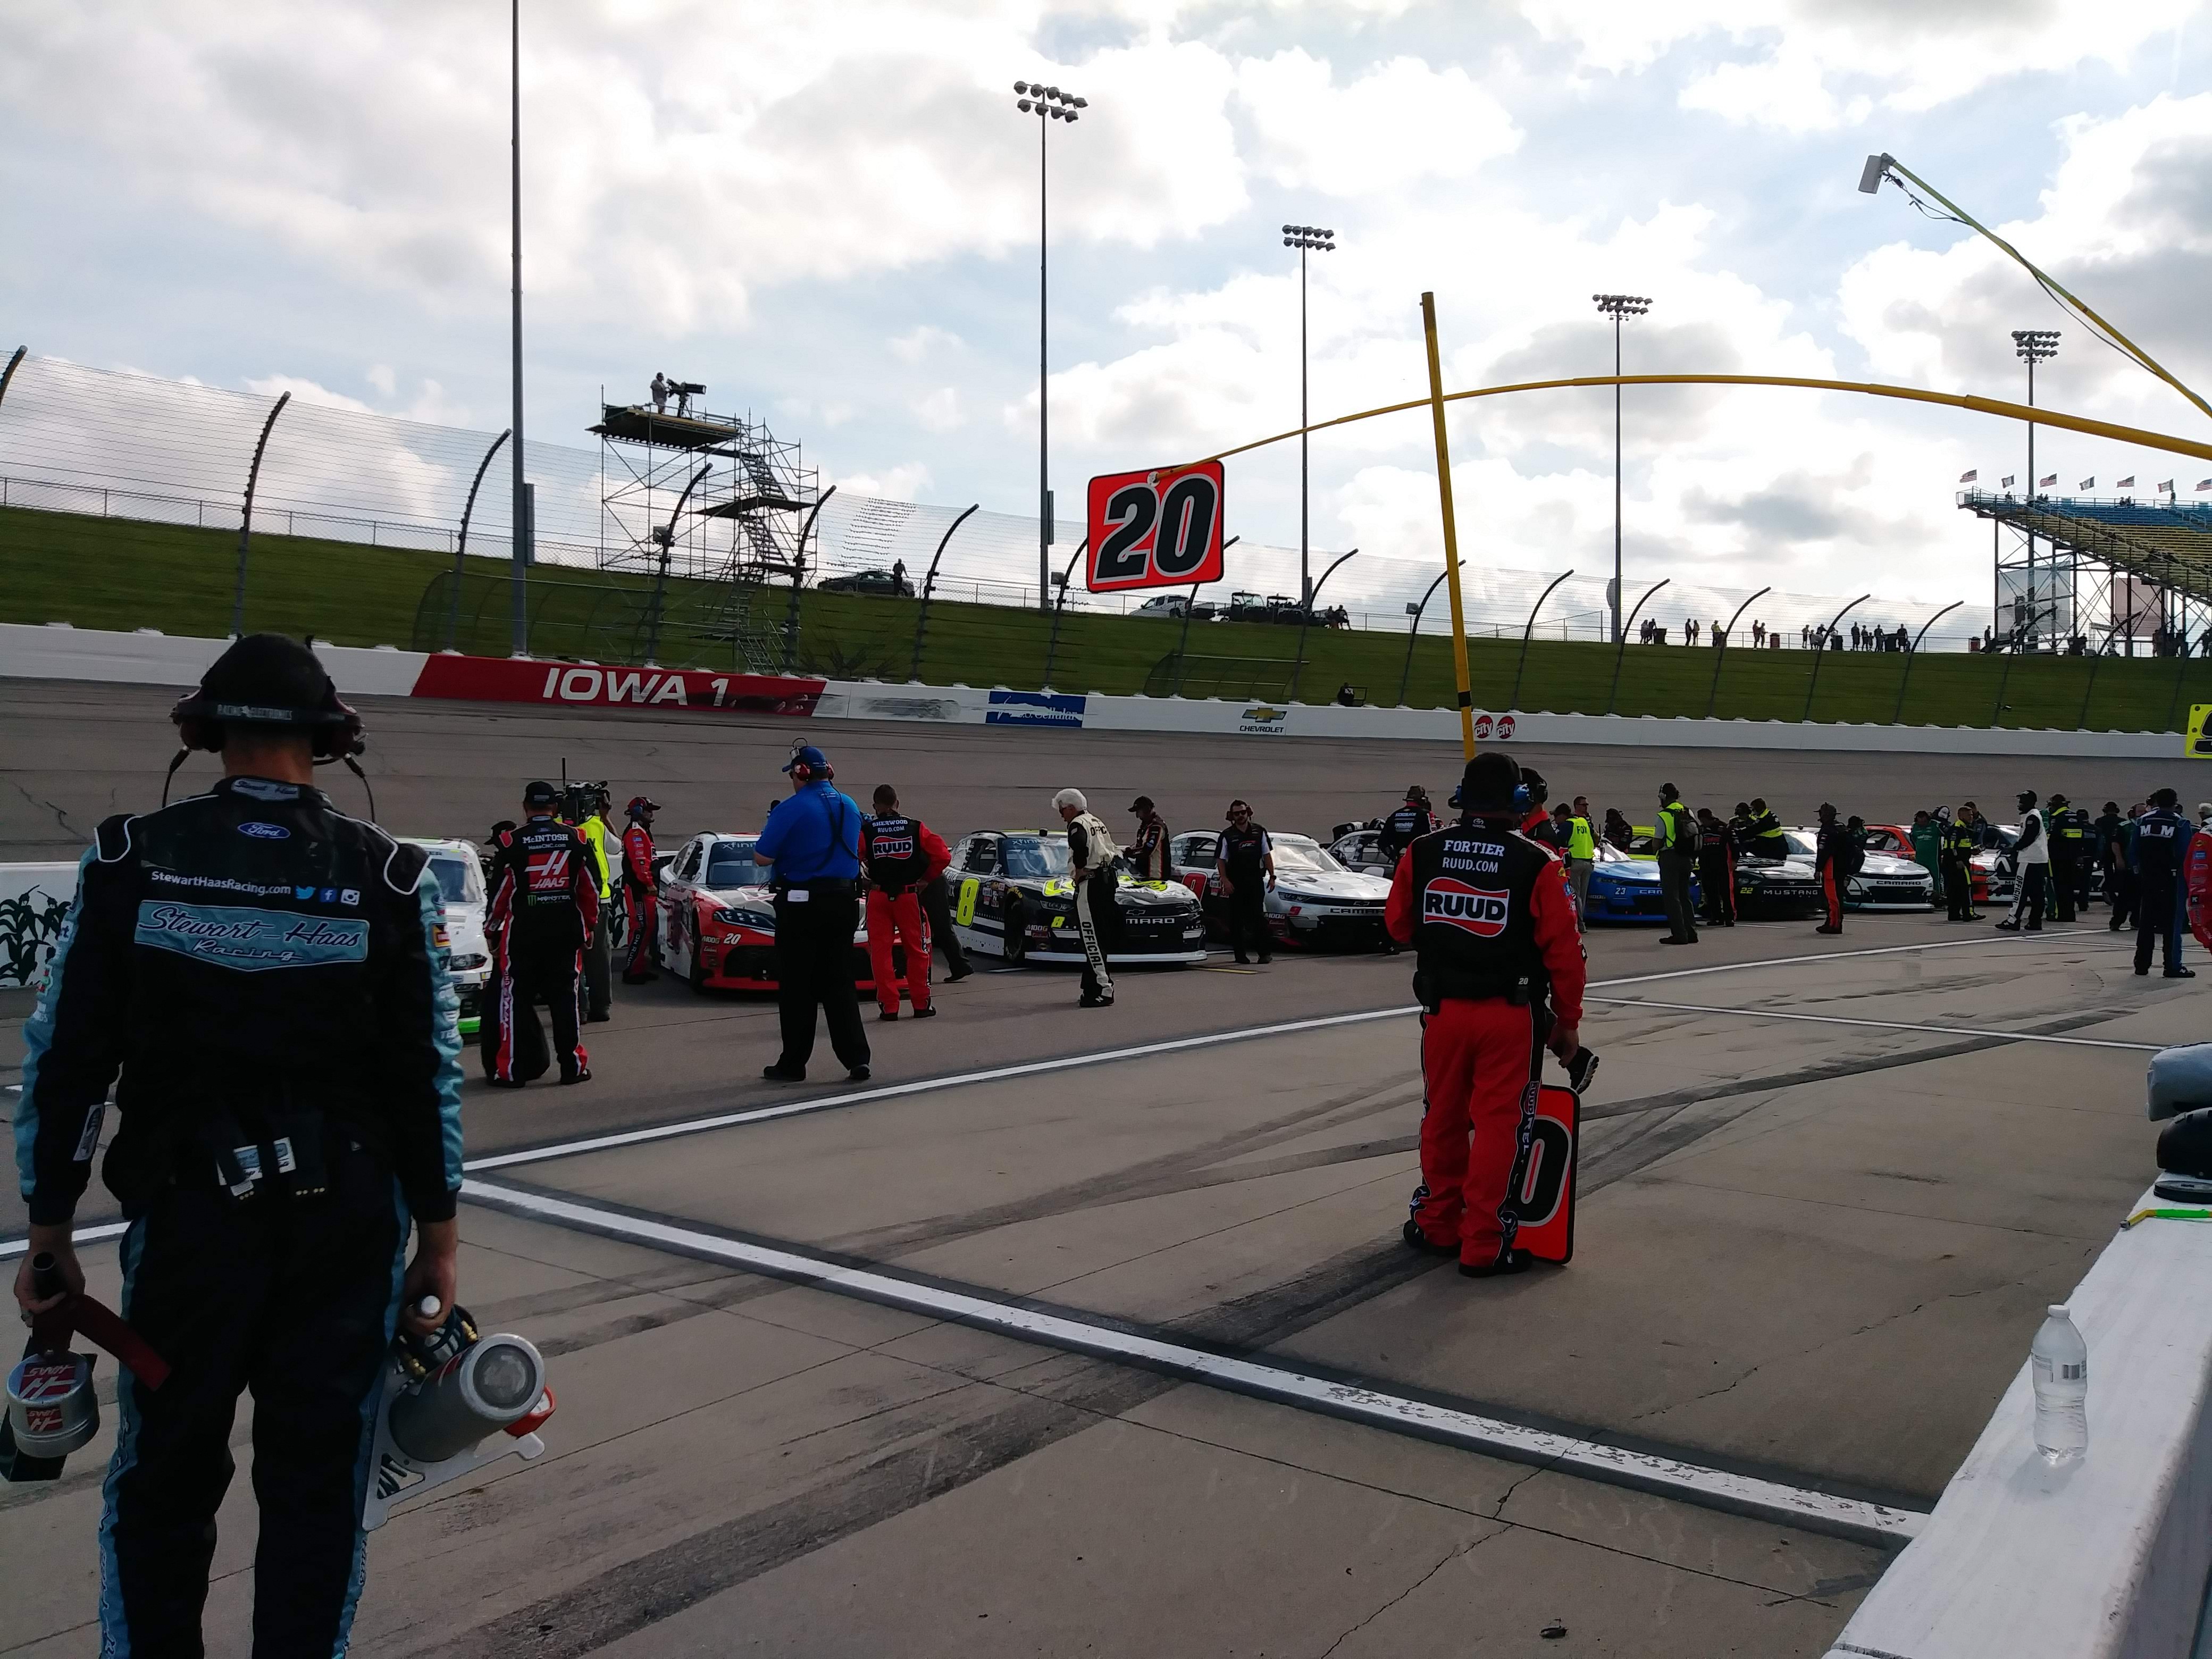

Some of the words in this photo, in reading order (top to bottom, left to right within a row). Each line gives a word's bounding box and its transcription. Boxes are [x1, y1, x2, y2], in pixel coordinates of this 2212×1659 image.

[1092, 473, 1219, 584] 20
[543, 668, 689, 706] IOWA
[248, 824, 280, 836] Ford
[1577, 825, 1588, 834] FOX
[522, 833, 569, 844] McINTOSH
[874, 841, 912, 854] RUUD
[1443, 839, 1505, 857] FORTIER
[1442, 857, 1499, 873] RUUD.COM
[151, 871, 291, 895] StewartHaasRacing.com
[529, 877, 571, 889] HAAS
[956, 877, 981, 927] 8
[1425, 892, 1506, 921] RUUD
[1288, 906, 1302, 916] 9
[139, 906, 274, 940] Stewart
[285, 921, 361, 947] Haas
[1051, 916, 1066, 928] 8
[702, 935, 720, 944] MOOG
[723, 933, 742, 945] 20
[1082, 921, 1103, 969] OFFICIAL
[192, 940, 304, 961] Racing
